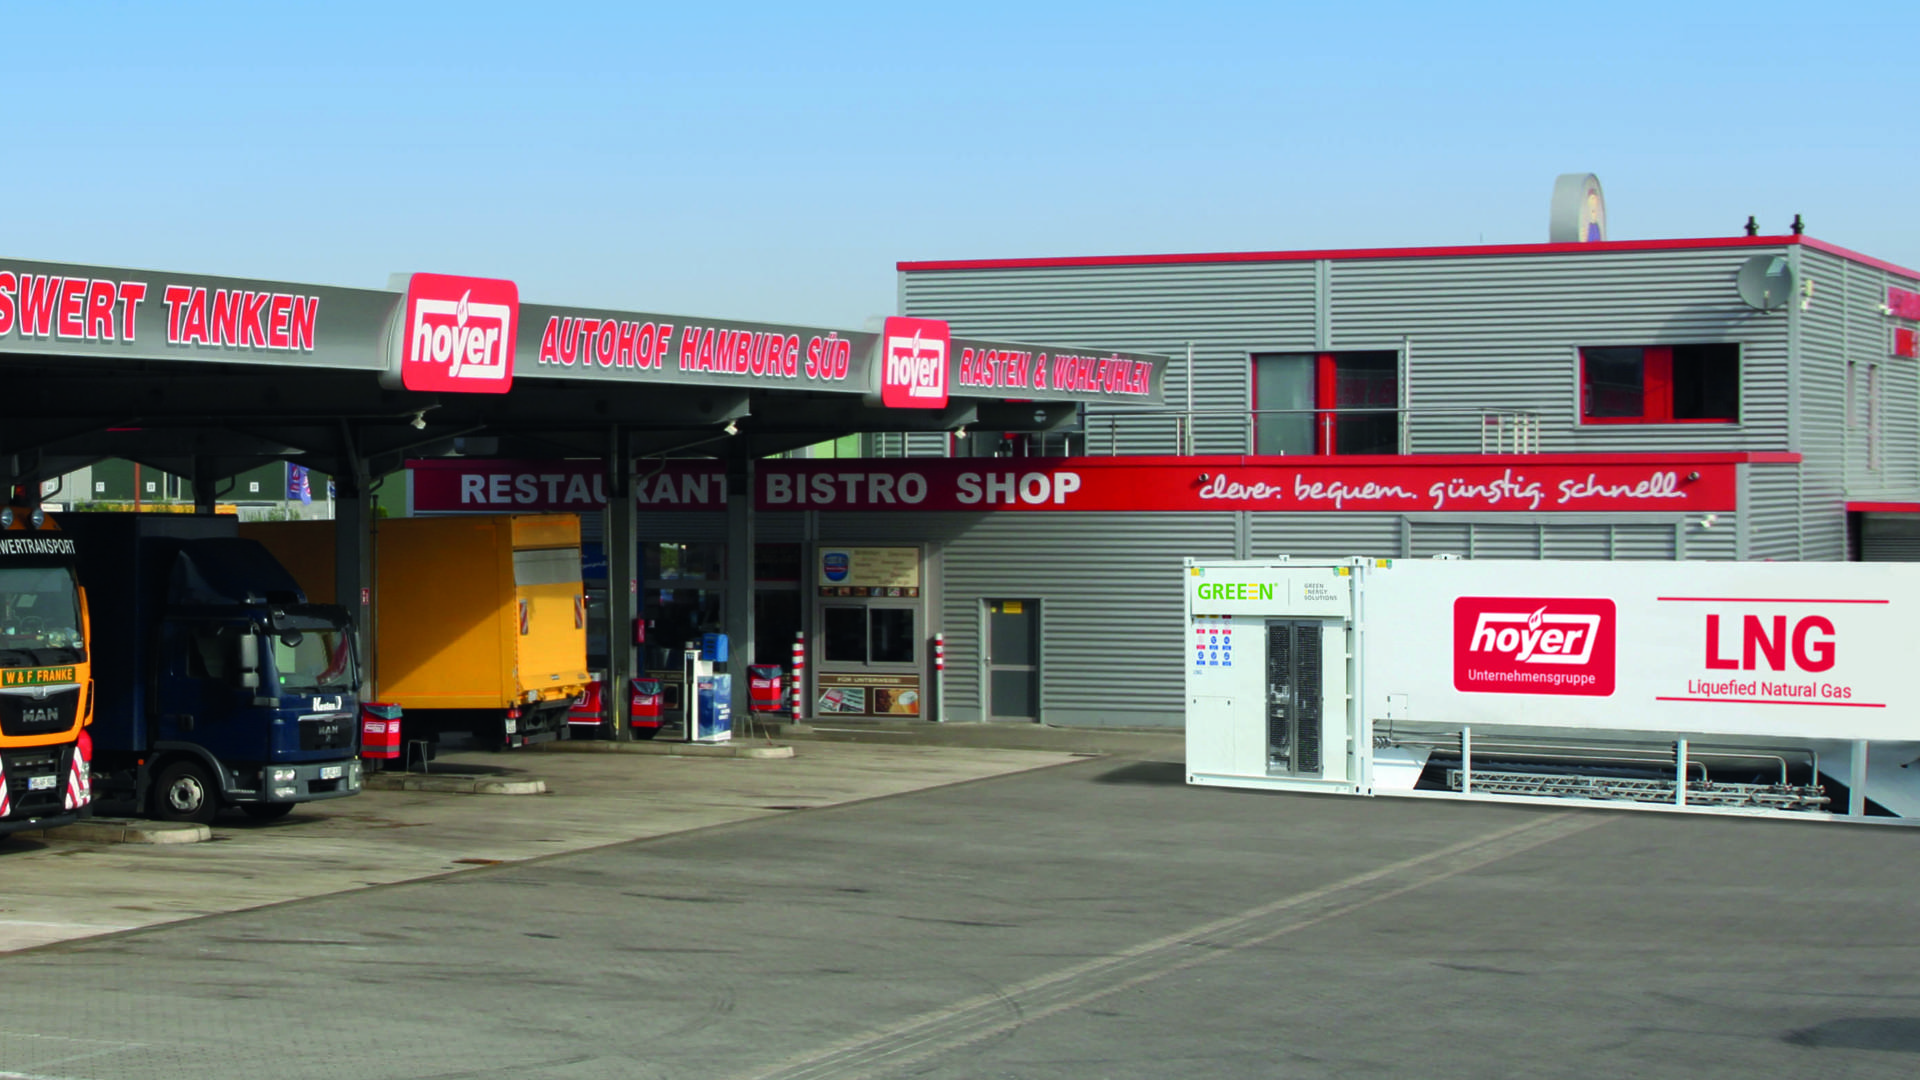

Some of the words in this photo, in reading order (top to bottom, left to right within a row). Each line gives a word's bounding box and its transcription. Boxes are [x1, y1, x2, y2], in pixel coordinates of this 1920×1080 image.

[0, 271, 147, 341] SWERT
[163, 284, 319, 351] TANKEN
[410, 299, 500, 378] hoyer
[539, 315, 674, 369] AUTOHOF
[679, 325, 800, 378] HAMBURG
[805, 332, 850, 380] SÜD
[887, 336, 939, 397] hoyer
[959, 347, 1032, 389] RASTEN
[1033, 352, 1047, 391] &
[1053, 353, 1153, 395] WOHLFÜHLEN
[766, 472, 928, 504] BISTRO
[956, 472, 1081, 504] SHOP
[1199, 473, 1282, 499] clever.
[1294, 473, 1418, 509] bequem.
[1428, 468, 1546, 510] günstig.
[1556, 471, 1687, 503] schnell.
[1469, 613, 1585, 661] hoyer
[1705, 614, 1836, 673] LNG
[6, 671, 16, 684] W
[17, 671, 24, 683] &
[27, 670, 33, 683] F
[37, 668, 73, 682] FRANKE
[1468, 669, 1596, 686] Unternehmensgruppe
[1688, 679, 1757, 697] Liquefied
[1761, 682, 1817, 698] Natural
[1821, 683, 1852, 698] Gas
[22, 707, 59, 722] MAN
